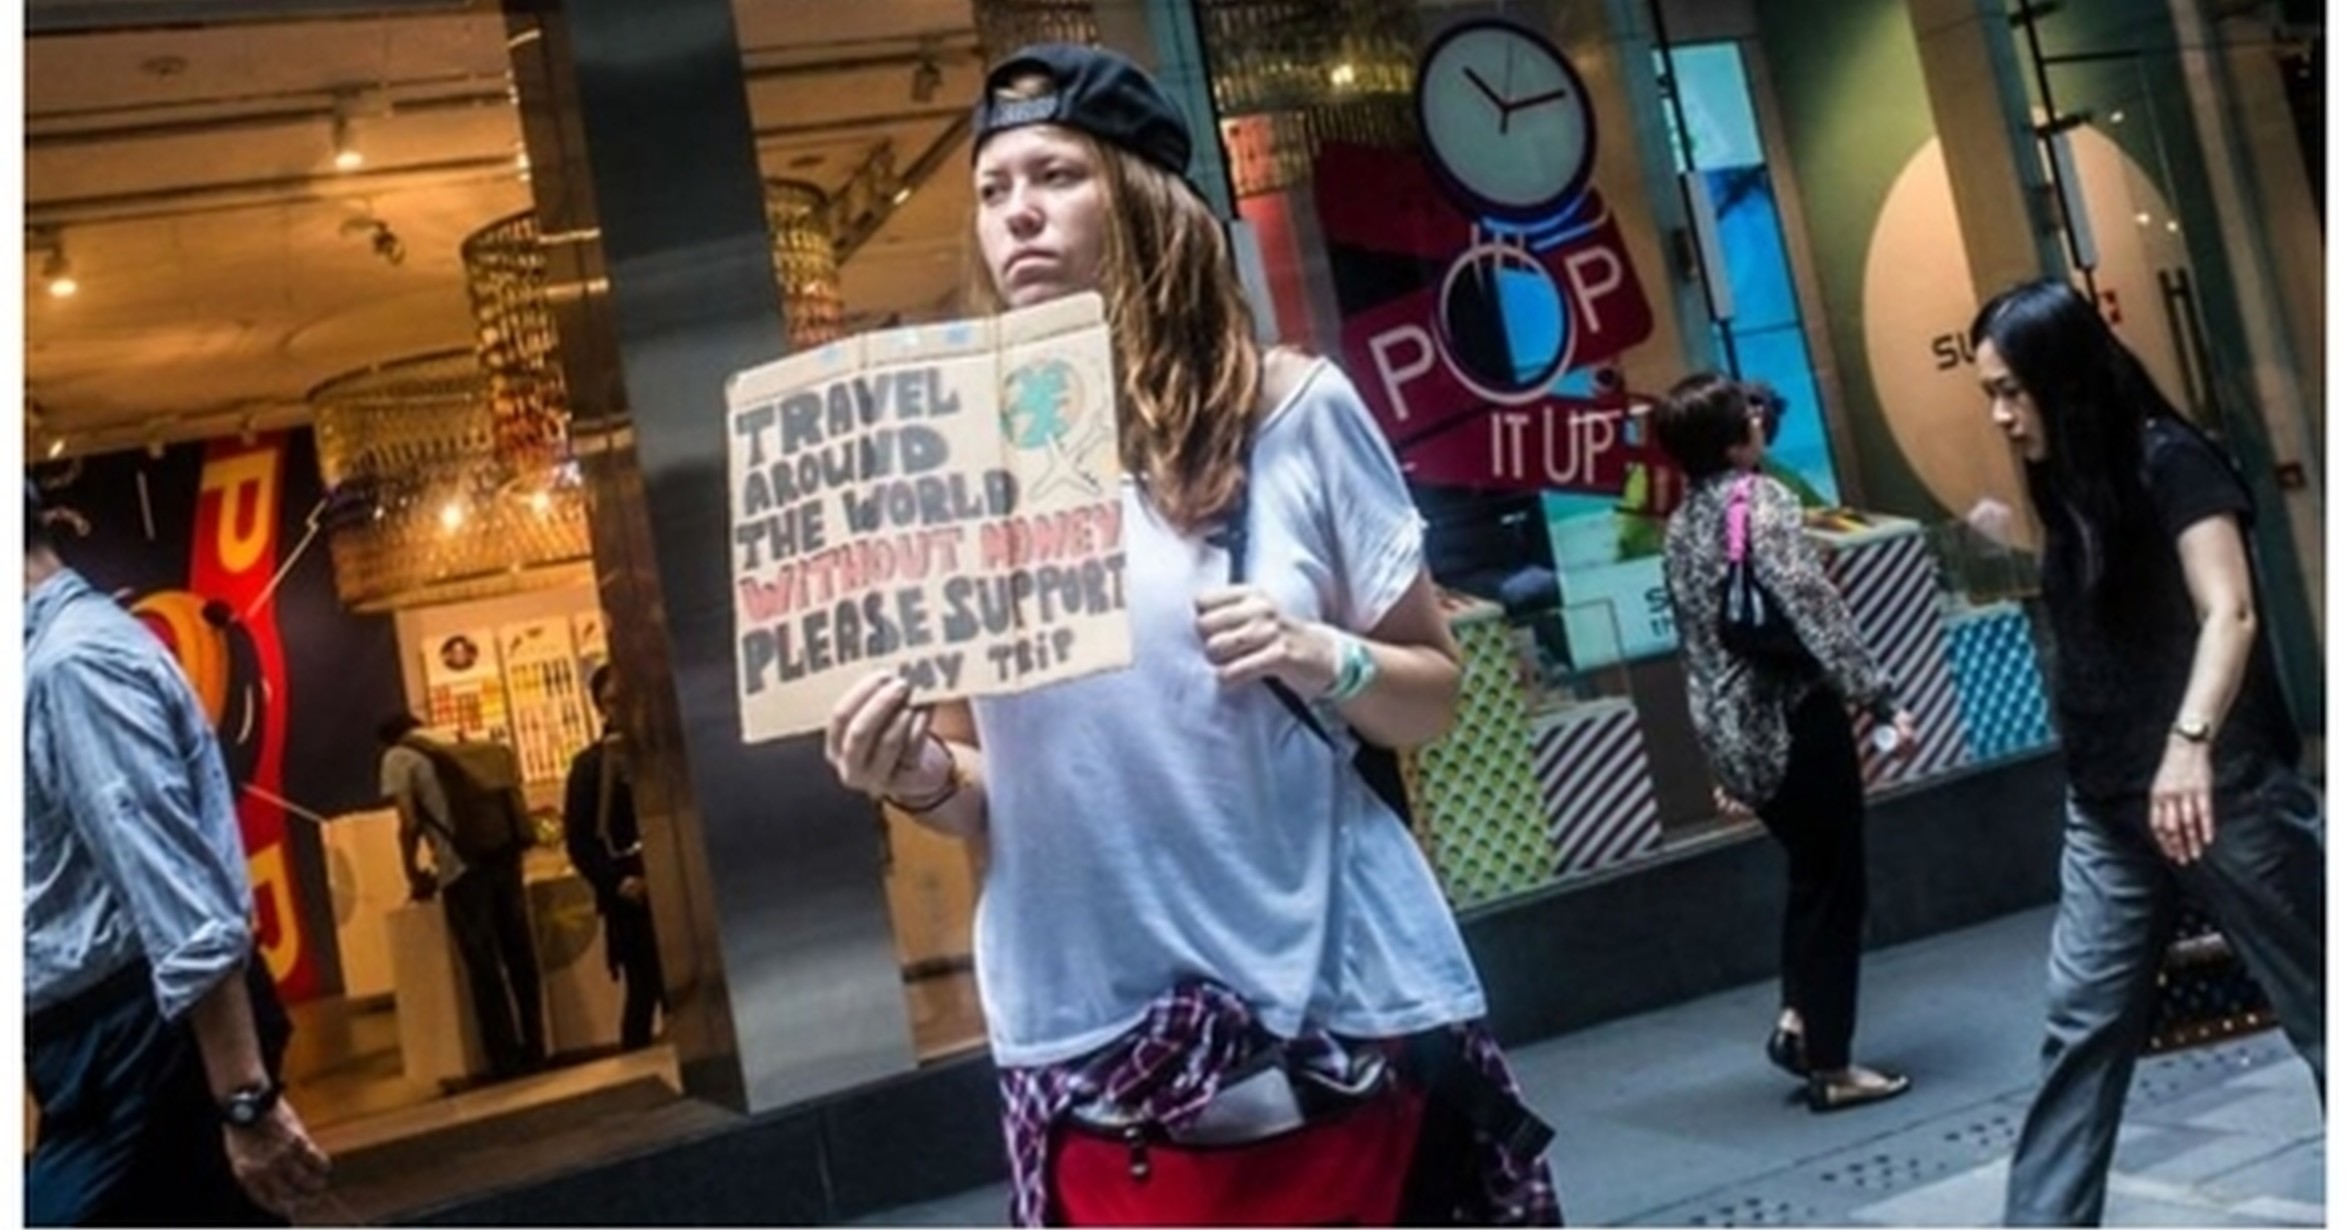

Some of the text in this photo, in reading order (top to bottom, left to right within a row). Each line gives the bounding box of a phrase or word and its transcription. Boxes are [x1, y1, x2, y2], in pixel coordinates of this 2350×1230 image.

[735, 367, 961, 468] TRAVEL
[1491, 406, 1615, 485] IT UP
[737, 469, 1019, 570] THE WORLD
[743, 425, 949, 516] AROUND
[739, 499, 1124, 622] WITHOUT MONEY
[741, 552, 1127, 695] PLEASE SUPPORT
[898, 651, 965, 690] MY
